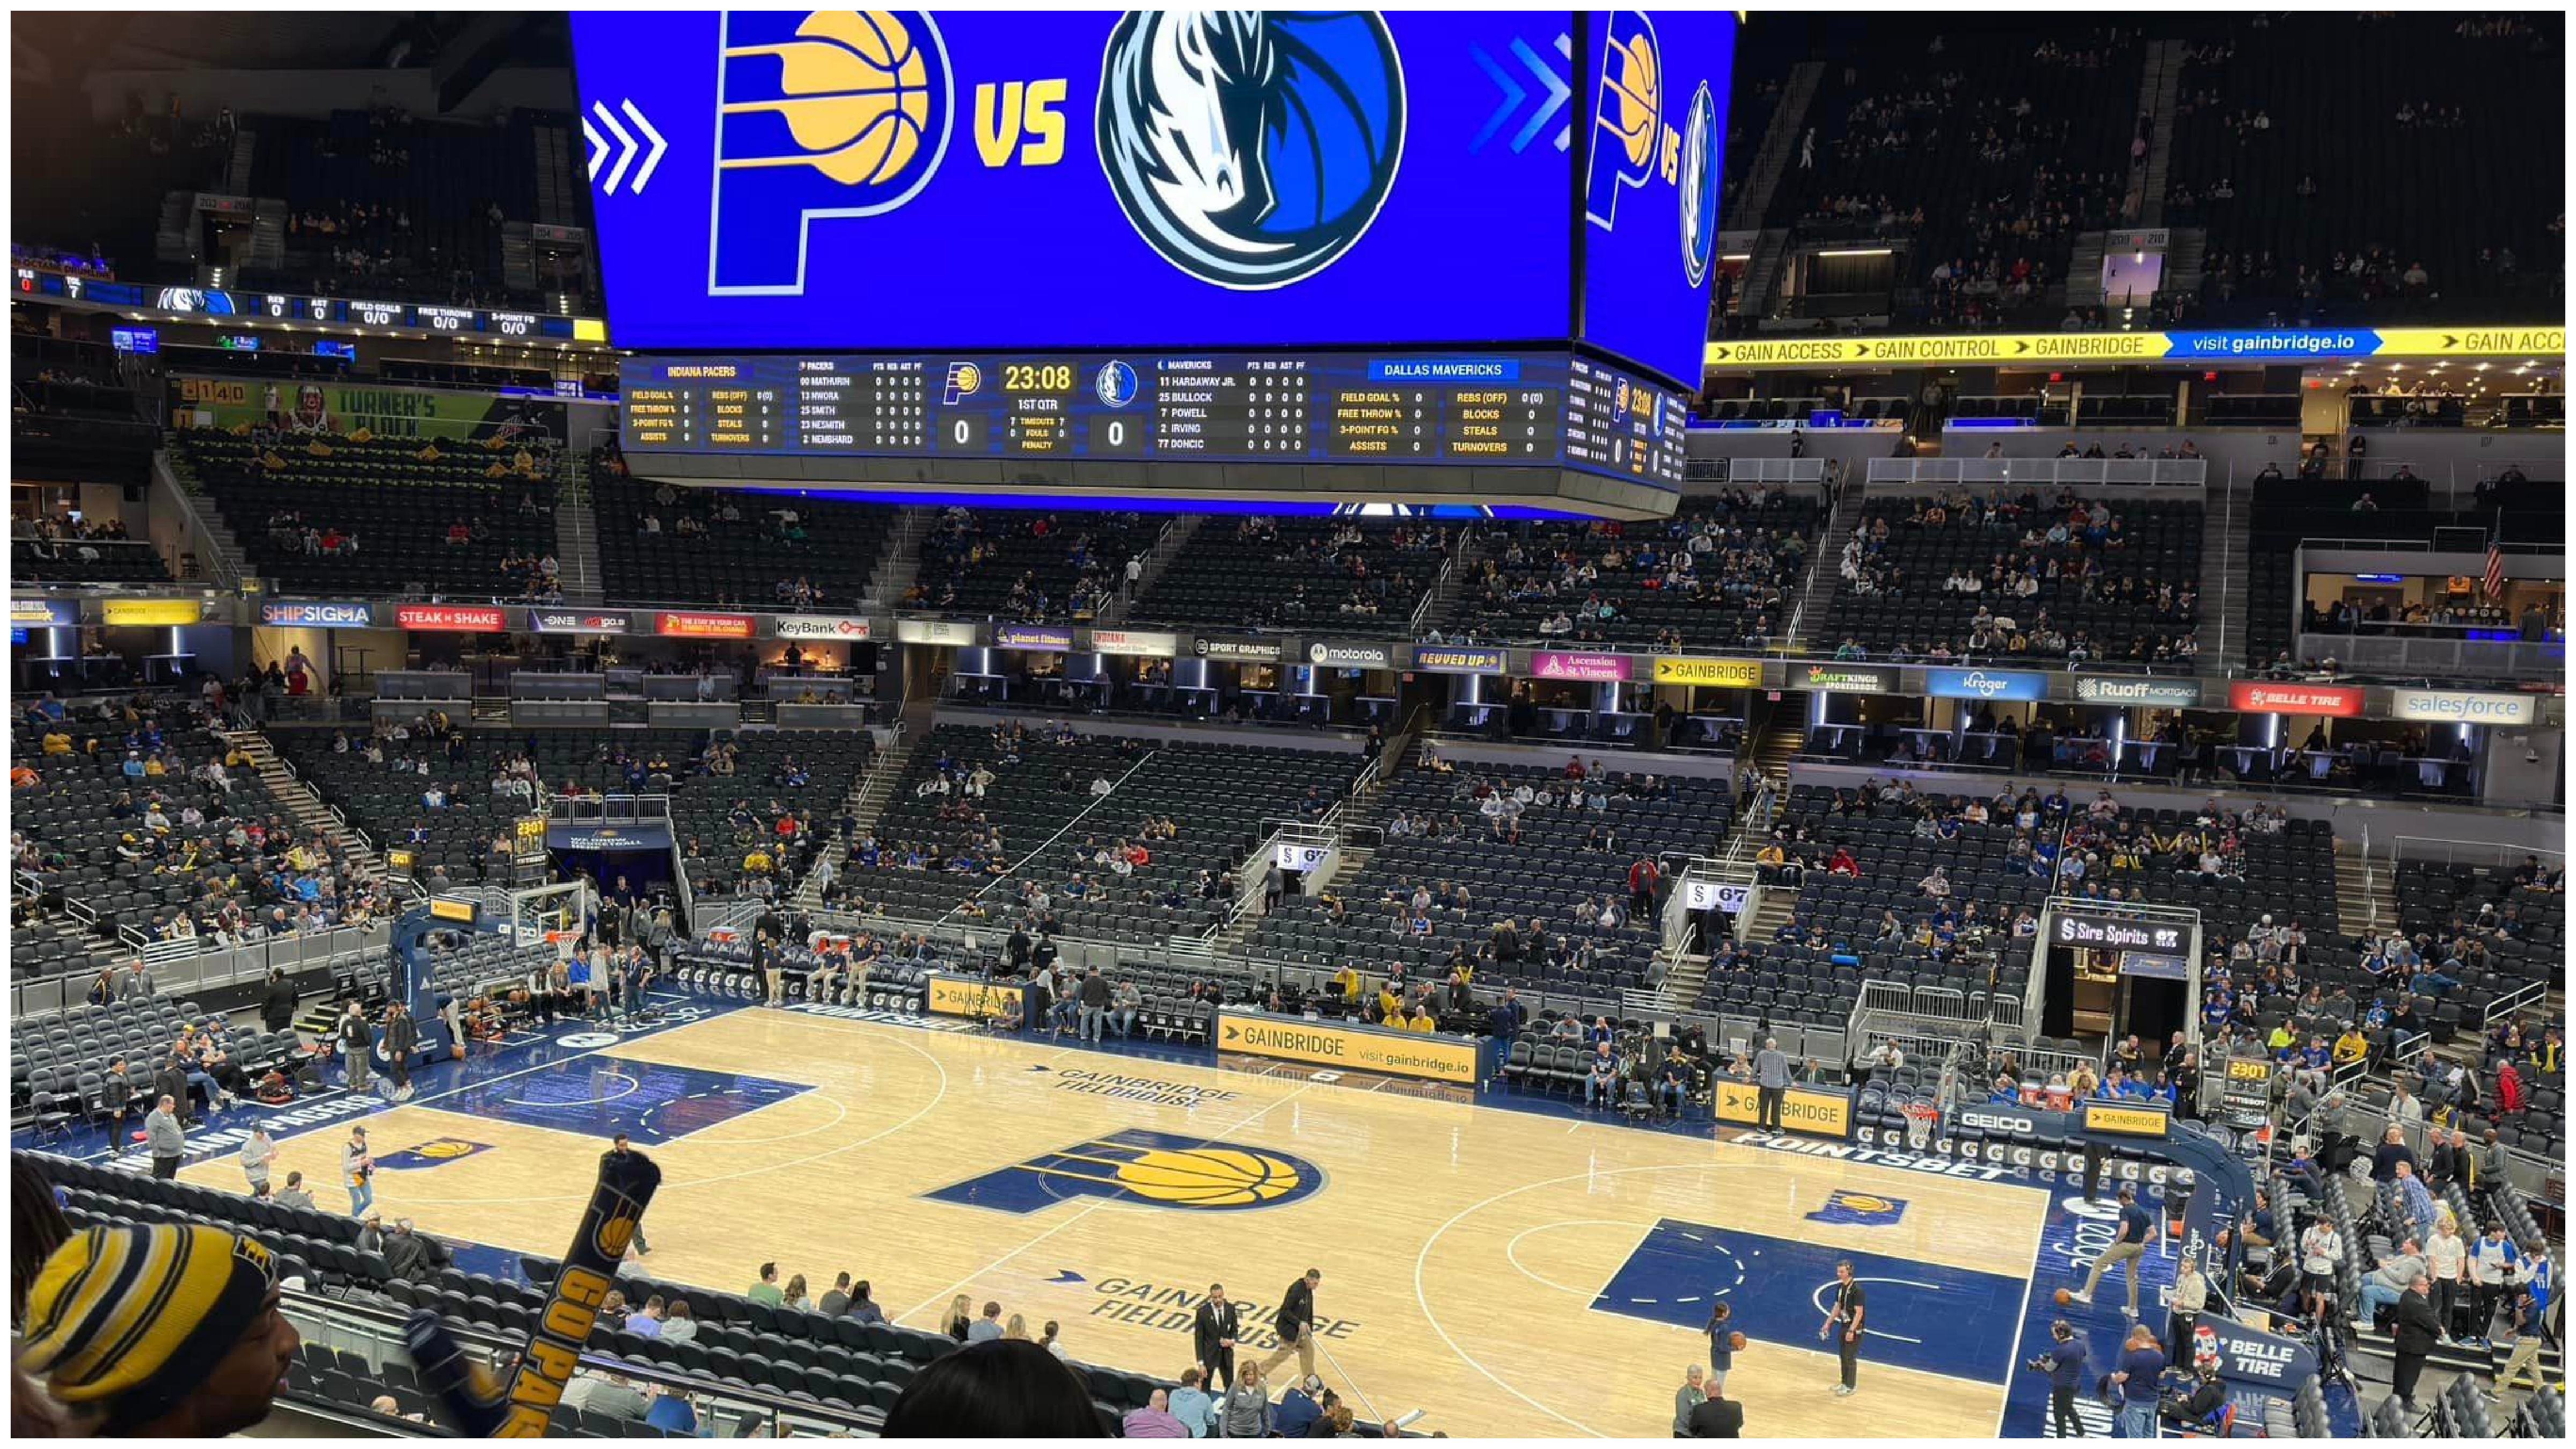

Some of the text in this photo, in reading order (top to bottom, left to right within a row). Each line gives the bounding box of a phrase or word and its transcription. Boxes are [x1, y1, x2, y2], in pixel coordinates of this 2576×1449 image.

[974, 78, 1067, 167] VS
[1661, 122, 1680, 185] VS
[21, 278, 31, 291] 0
[272, 305, 281, 316] 0
[314, 308, 324, 319] 0
[352, 301, 401, 313] FIELD GOALS
[418, 306, 472, 318] FREE THROWS
[364, 311, 389, 324] 0/0
[434, 317, 458, 330] 0/0
[501, 322, 525, 335] 0/0
[2036, 336, 2143, 356] GAINBRIDGE
[2193, 334, 2355, 353] visit gainbridge.io
[2465, 333, 2513, 350] GAIN
[1735, 343, 1842, 361] GAIN ACCESS
[1875, 339, 2000, 358] GAIN CONTROL
[1168, 361, 1212, 369] MAVERICKS
[1385, 365, 1502, 376] DALLAS MAVERICKS
[668, 367, 736, 377] INDIANA PACERS
[1005, 365, 1071, 390] 23:08
[1172, 377, 1220, 386] HARDAWAY
[340, 390, 435, 418] TURNER'S
[1019, 399, 1058, 409] 1ST QTR
[1159, 393, 1212, 402] 25 BULLOCK
[1341, 393, 1423, 402] FIELD GOAL 0
[1457, 393, 1543, 403] REBS (OFF) 0 (0)
[1161, 408, 1207, 417] 7 POWELL
[1337, 409, 1422, 418] FREE THROW 0
[1463, 410, 1535, 419] BLOCKS 0
[955, 420, 969, 443] 0
[1108, 422, 1123, 445] 0
[1161, 423, 1201, 433] 2 IRVING
[1340, 426, 1376, 435] 3-POINT
[1414, 426, 1421, 435] 0
[1463, 427, 1534, 435] STEALS 0
[1158, 440, 1169, 448] 77
[1350, 442, 1420, 451] ASSISTS 0
[1453, 443, 1533, 452] TURNOVERS 0
[262, 605, 369, 622] SHIPSIGMA
[399, 611, 500, 625] STEAK SHAKE
[777, 621, 836, 634] KeyBank
[1011, 633, 1039, 643] planet
[1210, 643, 1281, 655] SPORT GRAPHICS
[1329, 648, 1384, 661] motorola
[1419, 653, 1466, 664] REVVED
[1567, 656, 1616, 666] Ascension
[1582, 667, 1618, 677] Vincent
[1675, 665, 1756, 679] GAINBRIDGE
[1810, 673, 1877, 683] DRAFTKINGS
[1963, 671, 2007, 696] Kroger
[2100, 681, 2197, 697] Ruoff MORTGAGE
[2265, 694, 2341, 707] BELLE TIRE
[2409, 696, 2519, 718] salesforce
[1719, 888, 1747, 903] 67
[2077, 922, 2149, 945] Sire Spirits
[1245, 1027, 1468, 1073] GAINBRIDGE visit gainbridge.io
[1058, 1069, 1244, 1102] GAINBRIDGE
[1962, 1112, 2033, 1132] GEICO
[2104, 1113, 2161, 1128] GAINBRIDGE
[1731, 1131, 2018, 1180] POINTSBET
[542, 1265, 611, 1341] GO
[2230, 1339, 2294, 1363] BELLE
[2236, 1356, 2282, 1377] TIRE
